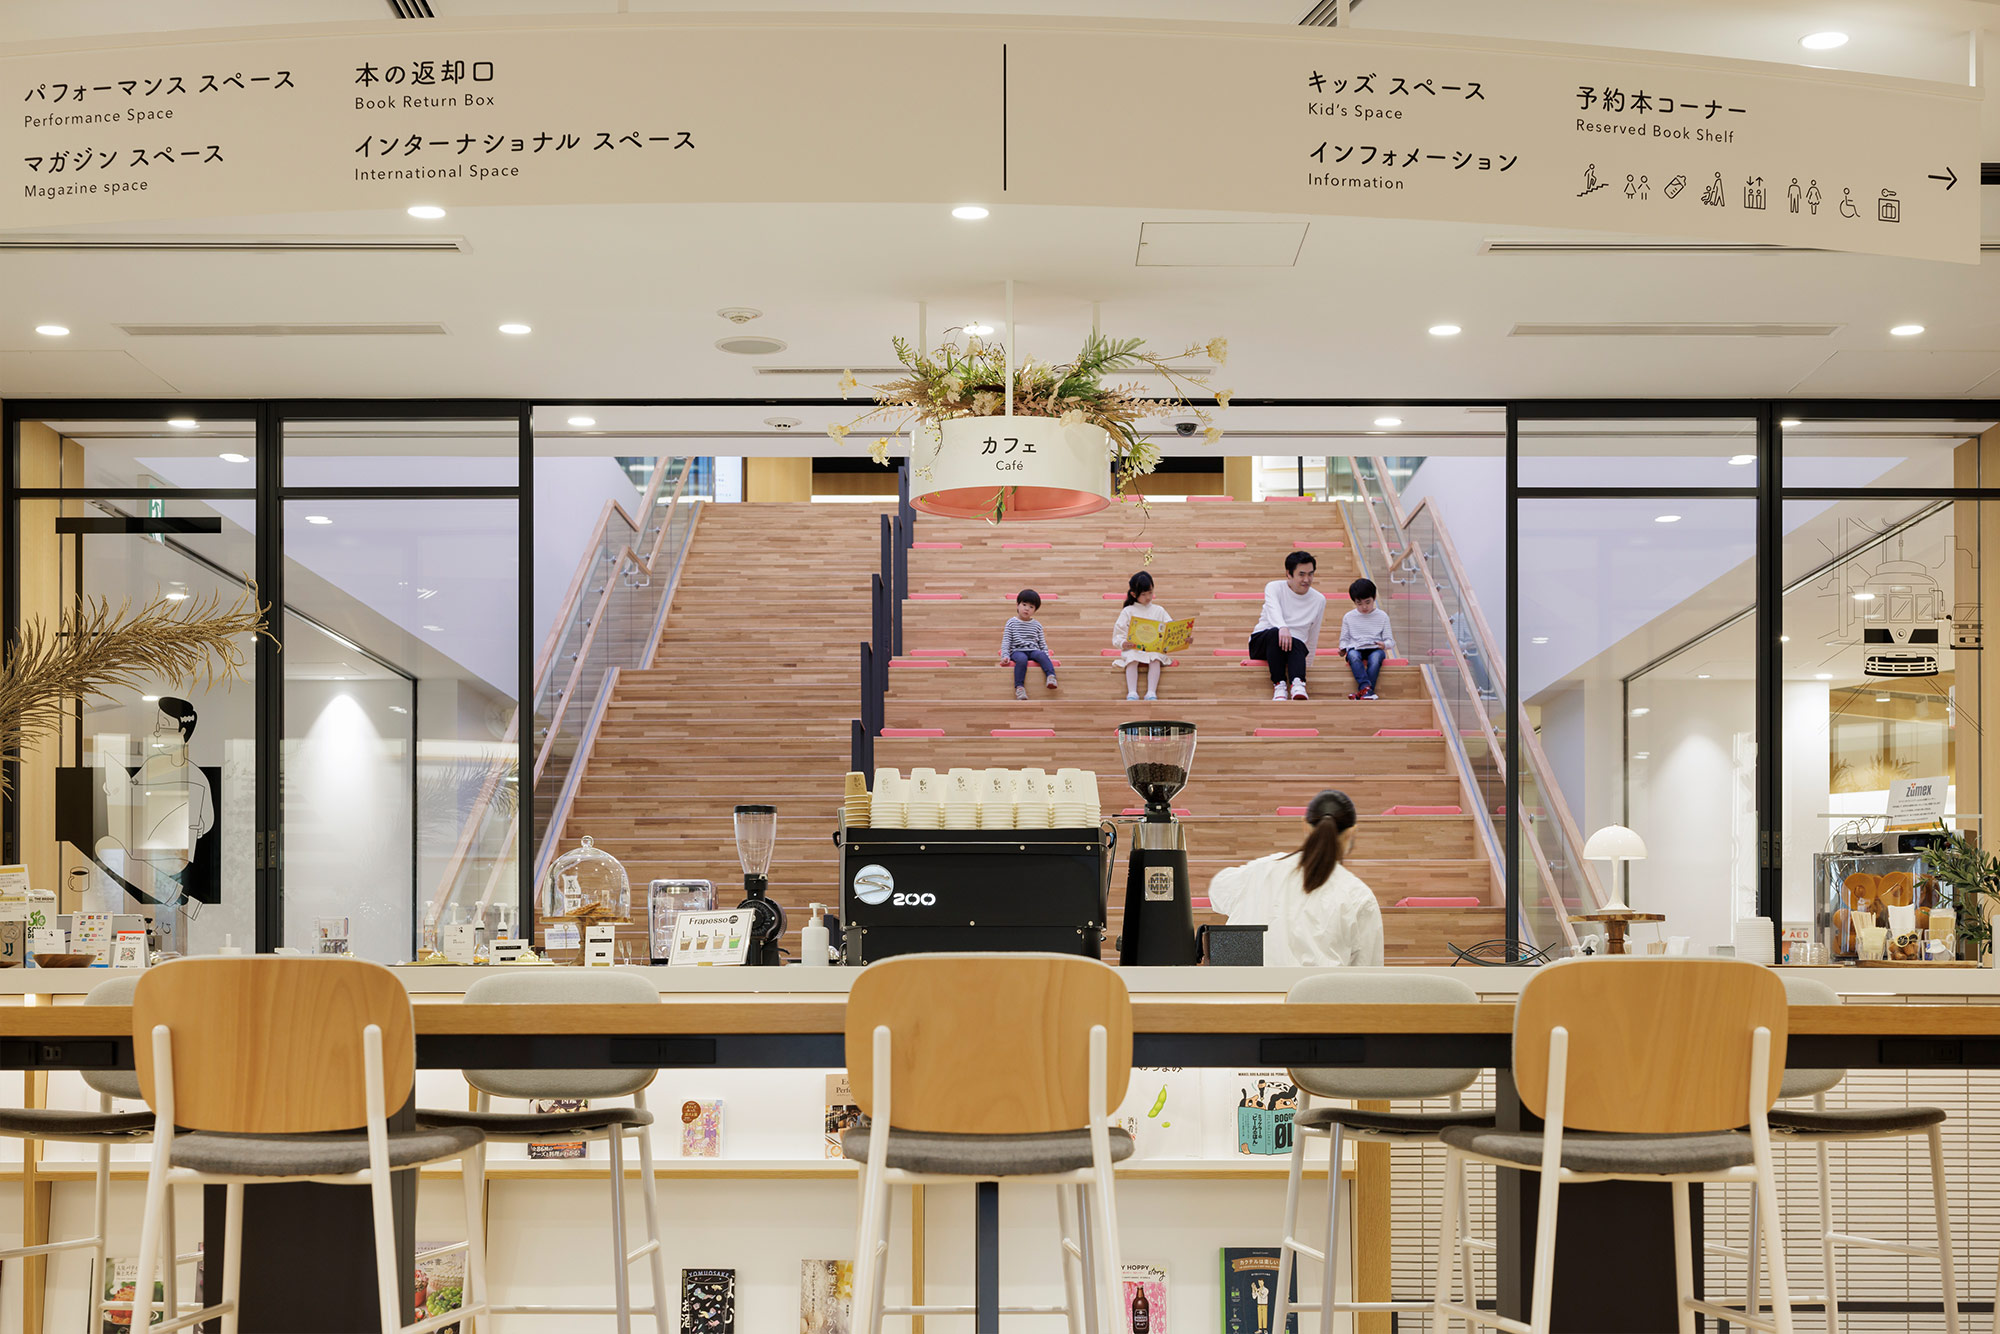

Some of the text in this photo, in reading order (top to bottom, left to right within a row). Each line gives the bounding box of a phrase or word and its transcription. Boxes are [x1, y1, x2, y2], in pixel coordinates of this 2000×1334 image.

[355, 60, 494, 88] 本の返却口
[24, 70, 295, 104] パフォーマンス スペース
[1308, 70, 1485, 101] キッズ スペース
[355, 94, 494, 109] Book Return Box
[1308, 103, 1403, 121] Kid's Space
[1576, 86, 1747, 119] 予約本コーナー
[24, 107, 174, 128] Performance Space
[1576, 118, 1735, 144] Reserved Book Shelf
[354, 130, 696, 159] インターナショナル スペース
[24, 145, 224, 174] マガジン スペース
[1309, 141, 1518, 172] インフォメーション
[354, 164, 520, 181] International Space
[1308, 173, 1404, 190] Information
[24, 181, 148, 200] Magazine space
[981, 435, 1037, 456] カフェ
[995, 459, 1024, 471] Café
[892, 892, 936, 906] 200
[688, 916, 728, 926] Frapesso
